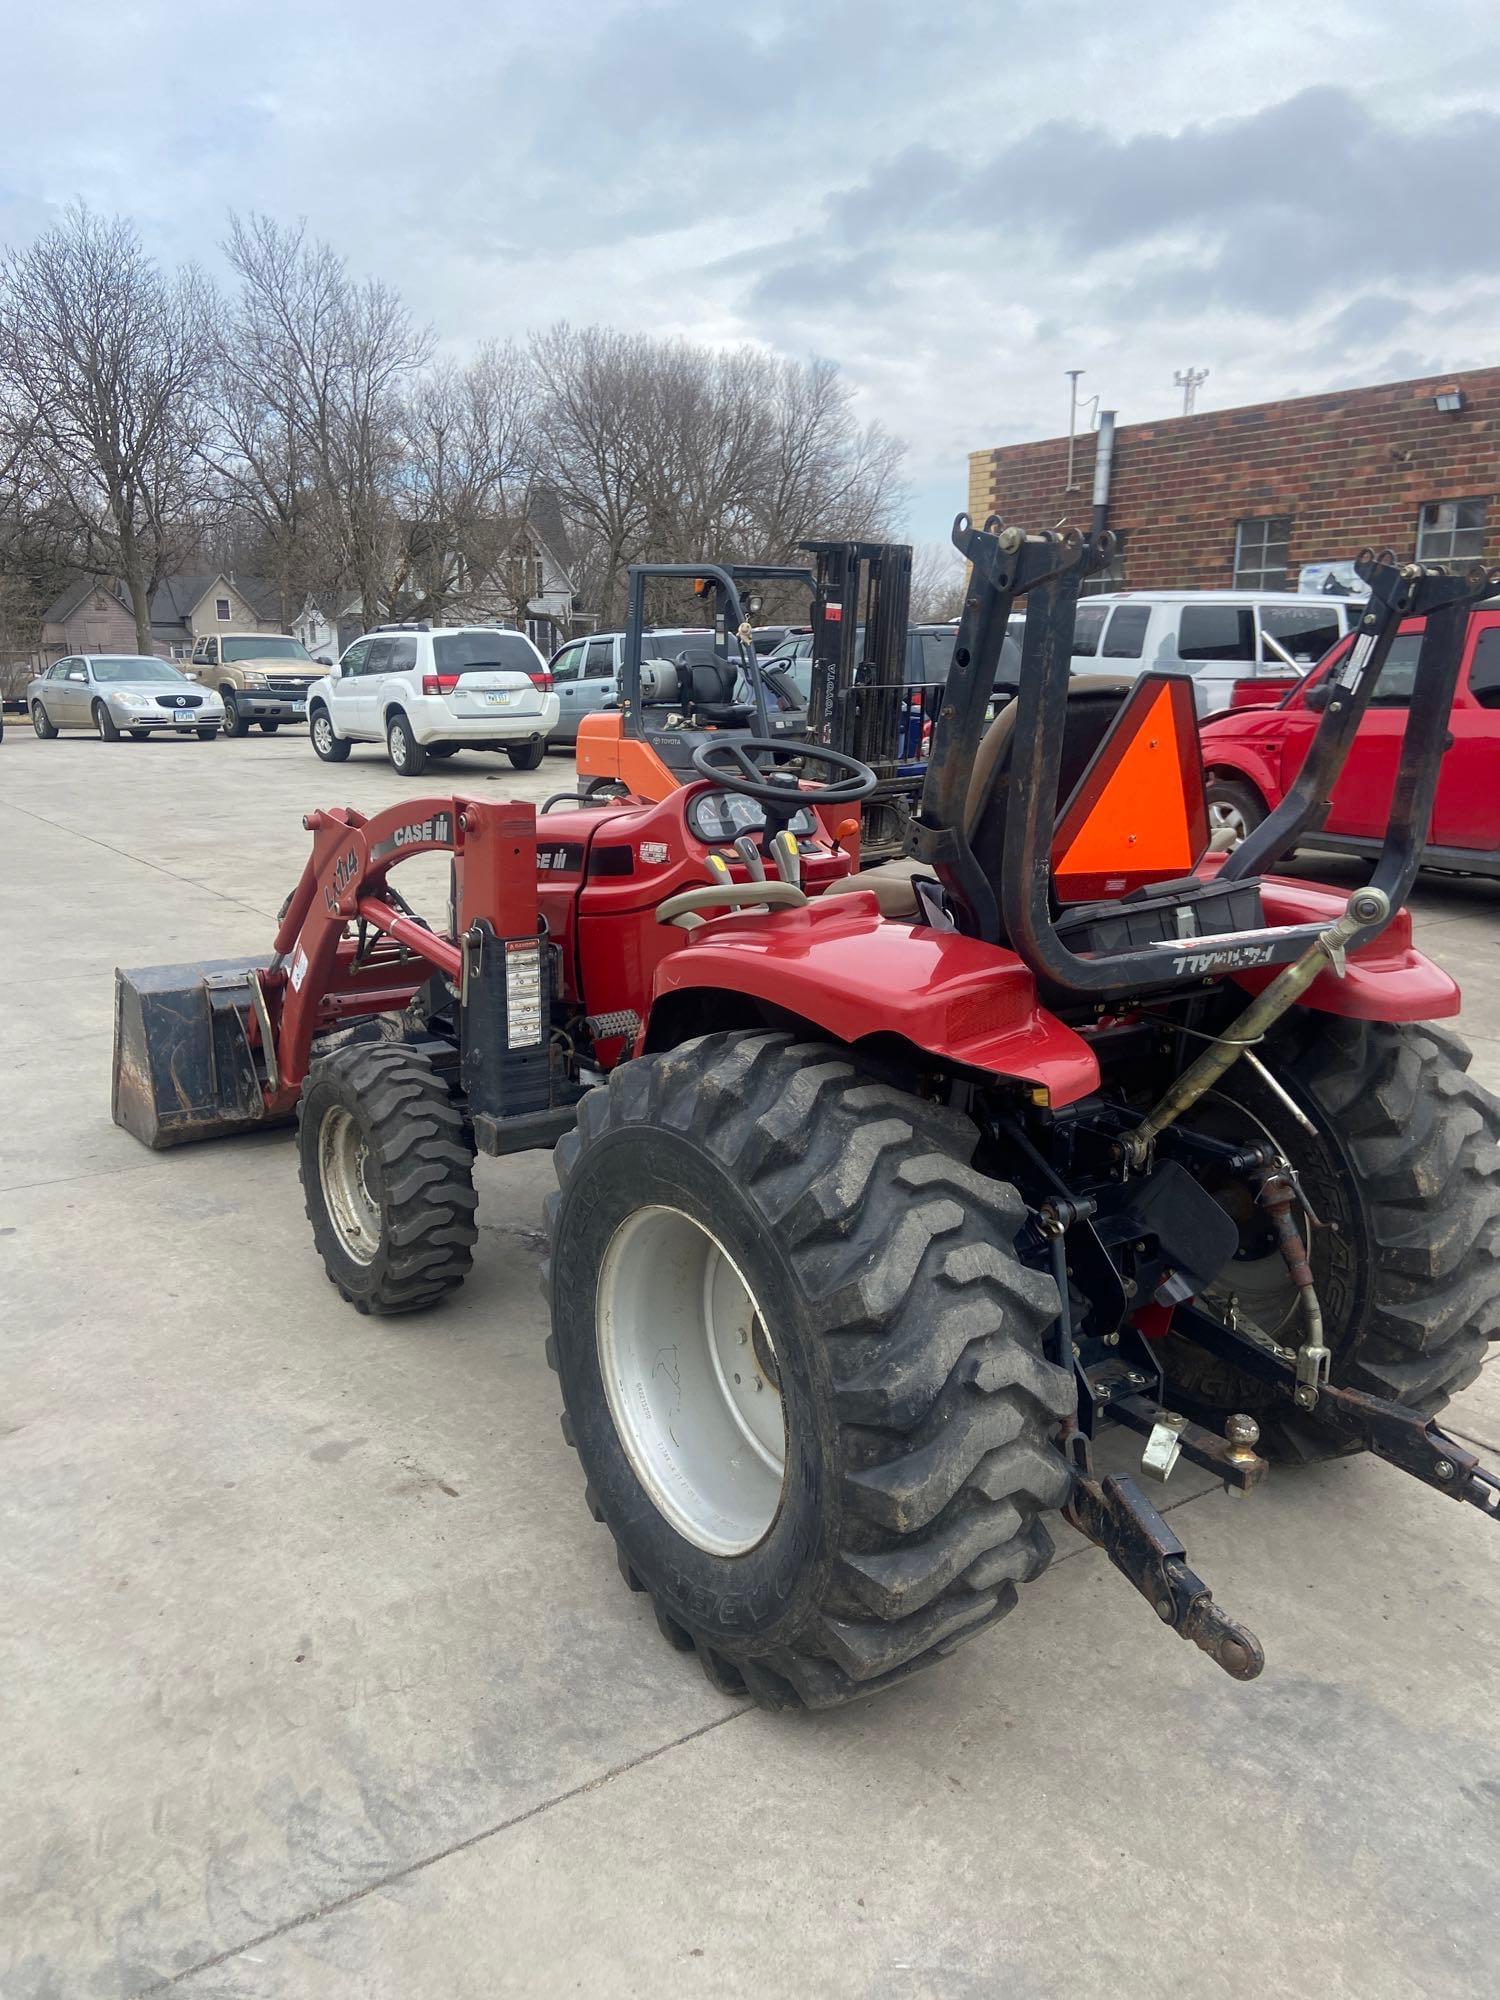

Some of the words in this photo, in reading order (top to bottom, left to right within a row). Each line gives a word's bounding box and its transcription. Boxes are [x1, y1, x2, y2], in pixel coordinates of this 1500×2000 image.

[825, 663, 836, 716] TOYOTA
[394, 821, 432, 846] CASE
[1172, 944, 1275, 975] FALL
